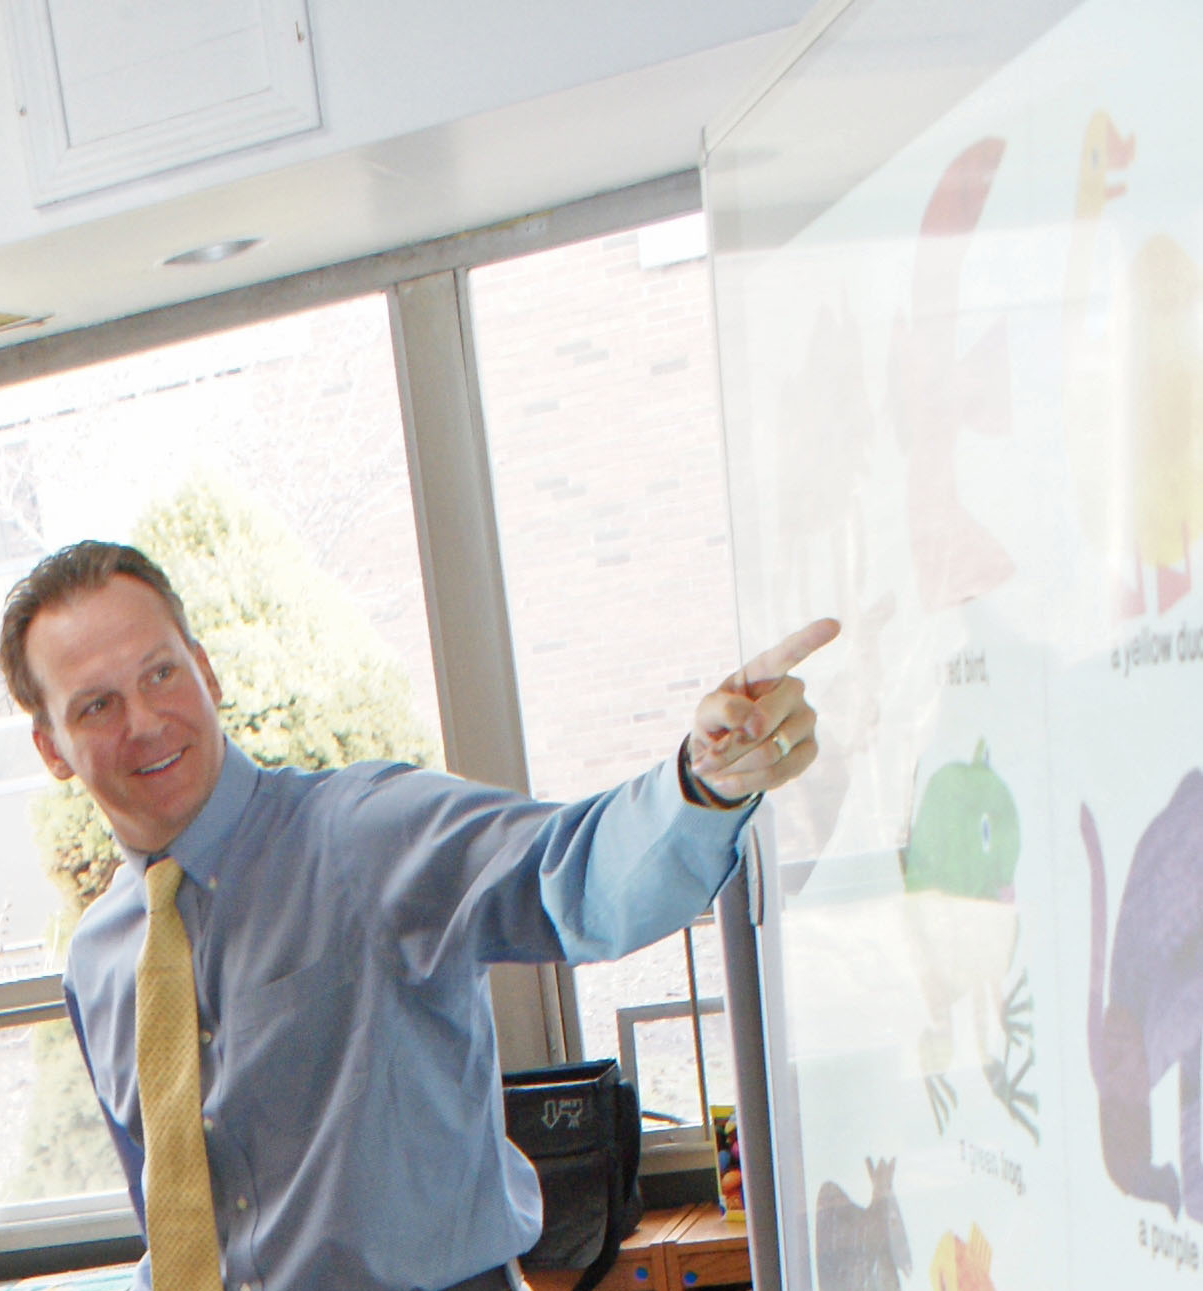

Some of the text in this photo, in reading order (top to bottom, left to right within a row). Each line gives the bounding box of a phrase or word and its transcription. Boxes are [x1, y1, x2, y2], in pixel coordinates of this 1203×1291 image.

[1111, 647, 1121, 670] a
[1124, 625, 1172, 678] yellow
[1138, 1218, 1199, 1272] a purple
